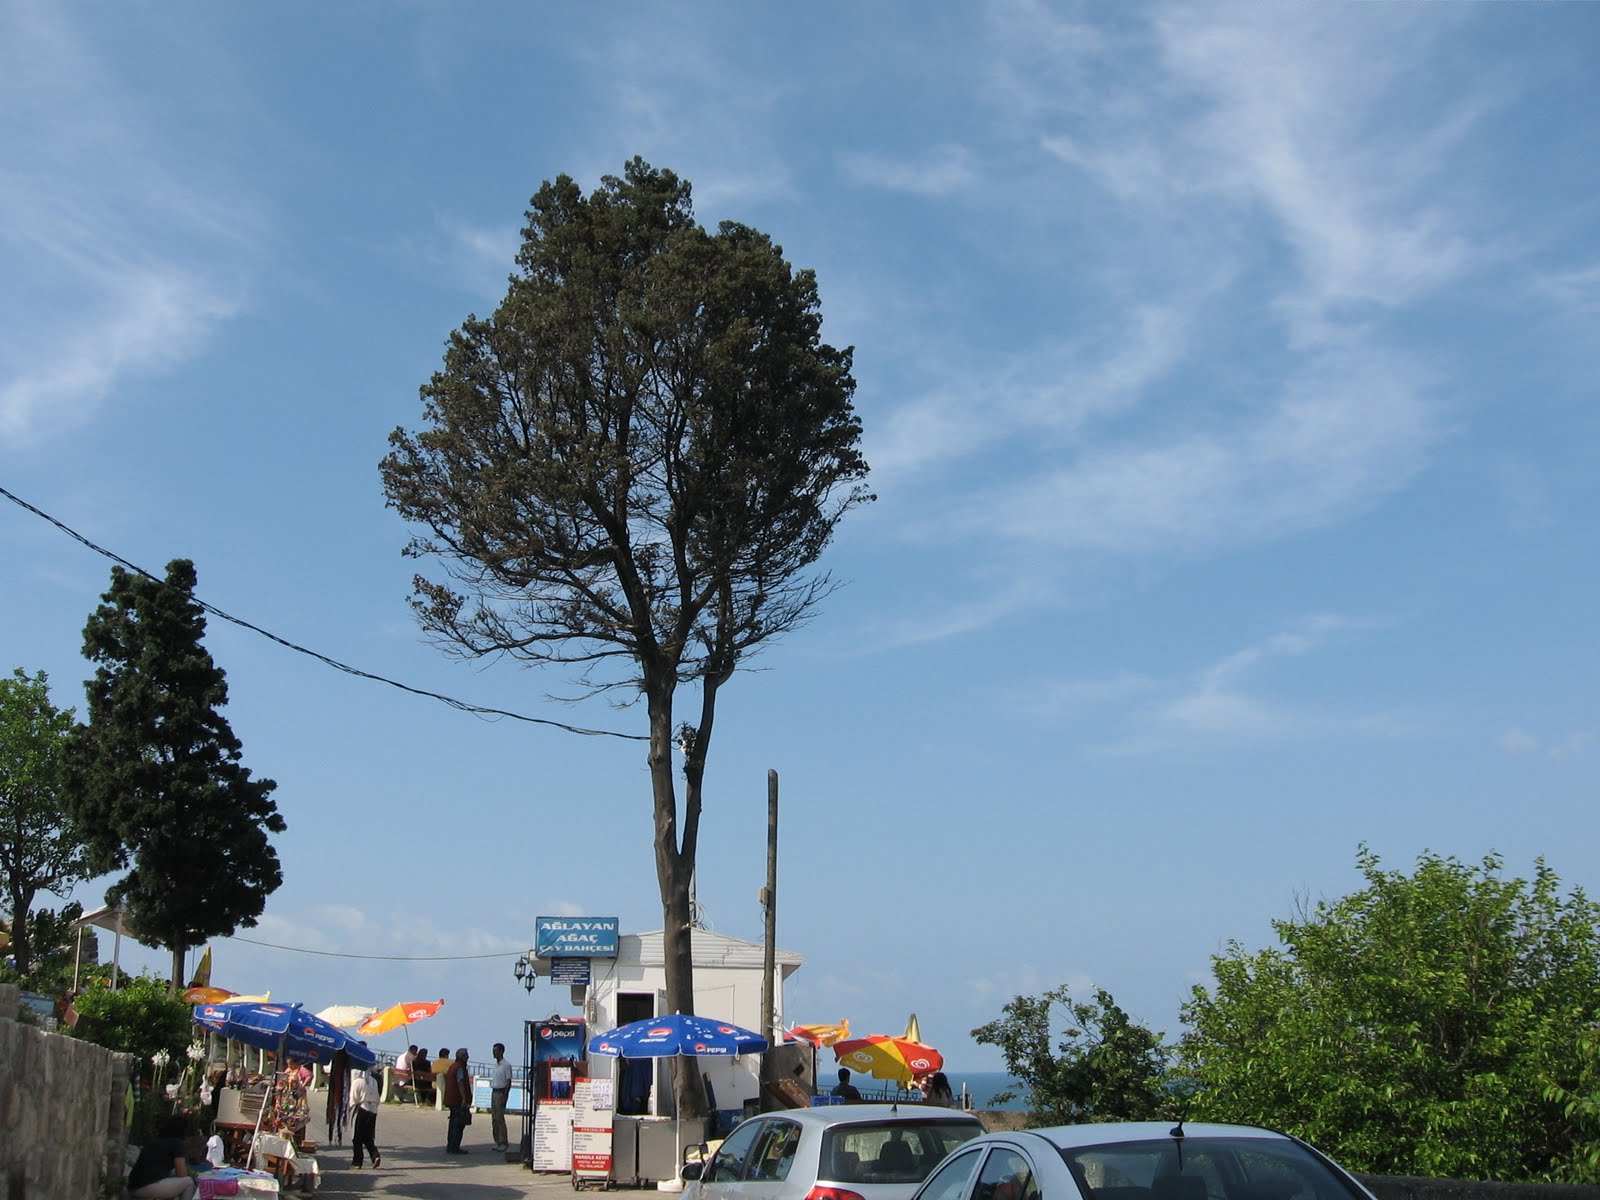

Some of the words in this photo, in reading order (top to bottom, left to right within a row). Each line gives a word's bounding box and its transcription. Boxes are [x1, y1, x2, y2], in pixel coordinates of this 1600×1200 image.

[540, 922, 614, 930] AĞLAYAN
[558, 933, 598, 944] AĞAÇ
[315, 1033, 335, 1044] PEPSI
[553, 1030, 575, 1038] pepsi
